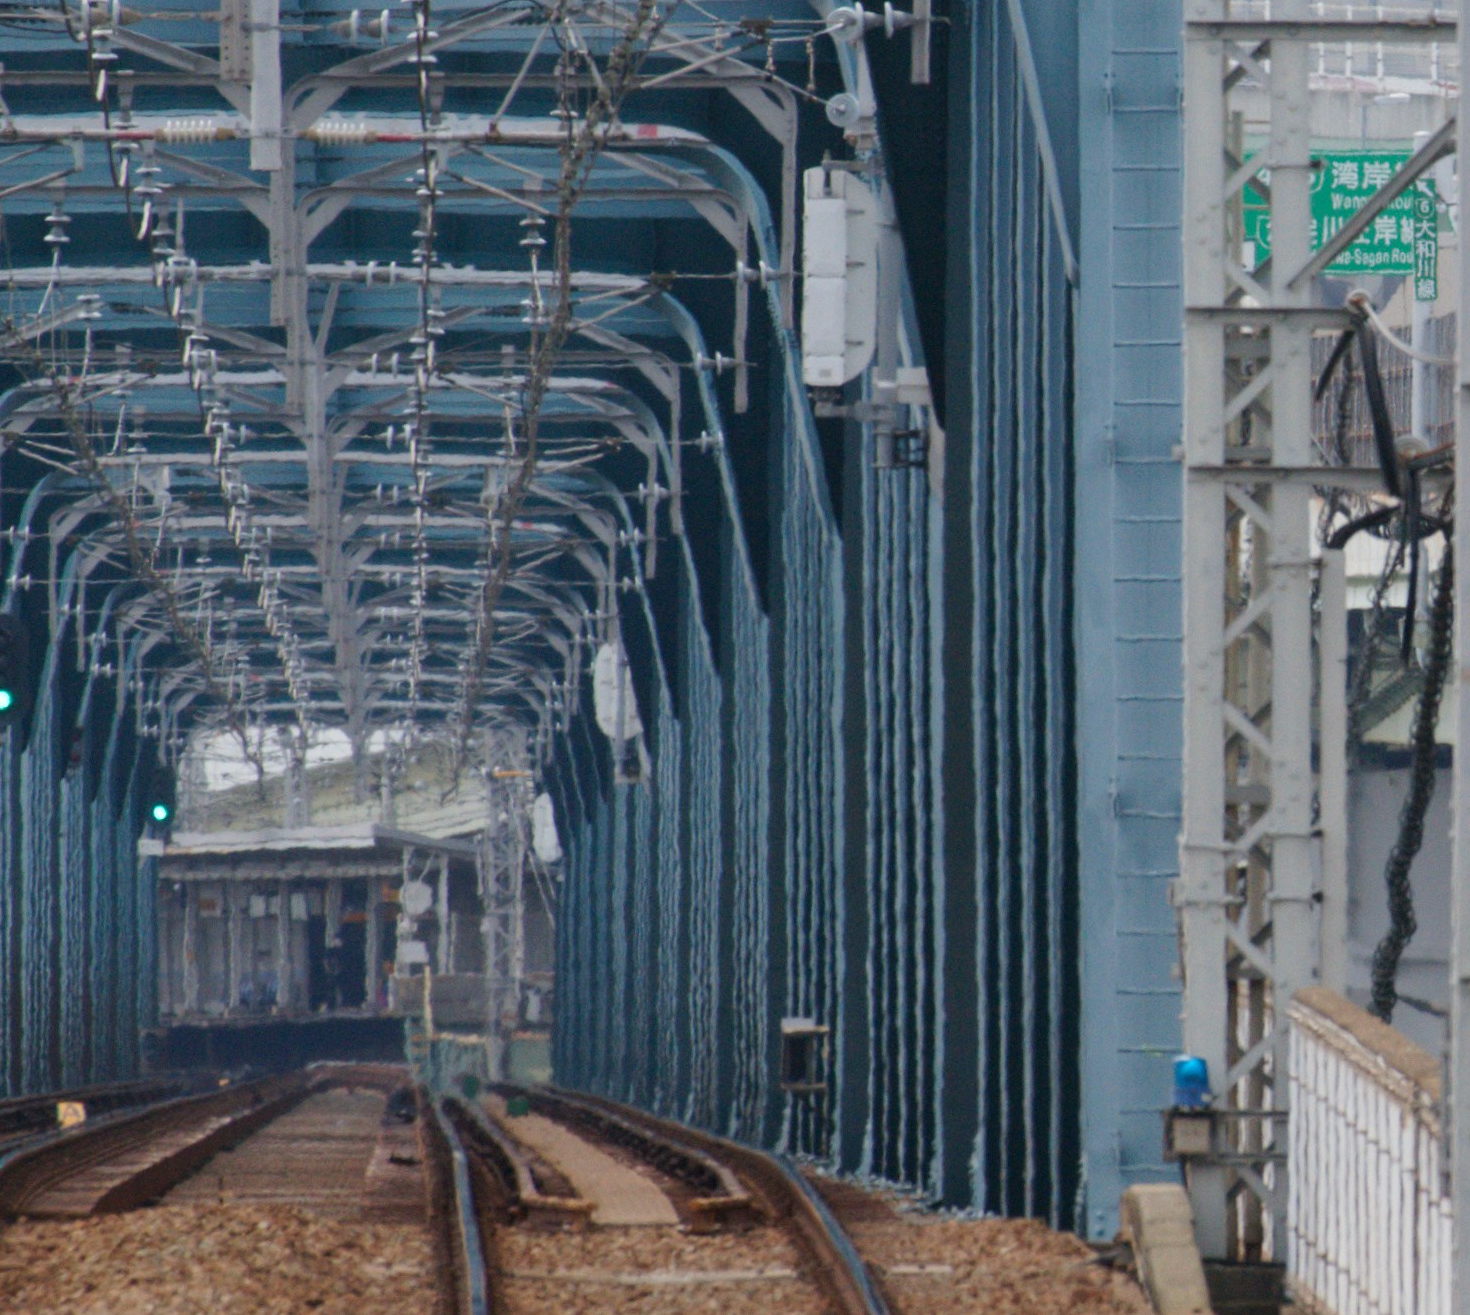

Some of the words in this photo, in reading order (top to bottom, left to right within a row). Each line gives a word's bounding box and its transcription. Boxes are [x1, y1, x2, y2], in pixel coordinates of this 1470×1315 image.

[1332, 161, 1414, 190] 湾岸
[1415, 220, 1436, 299] 大和川線
